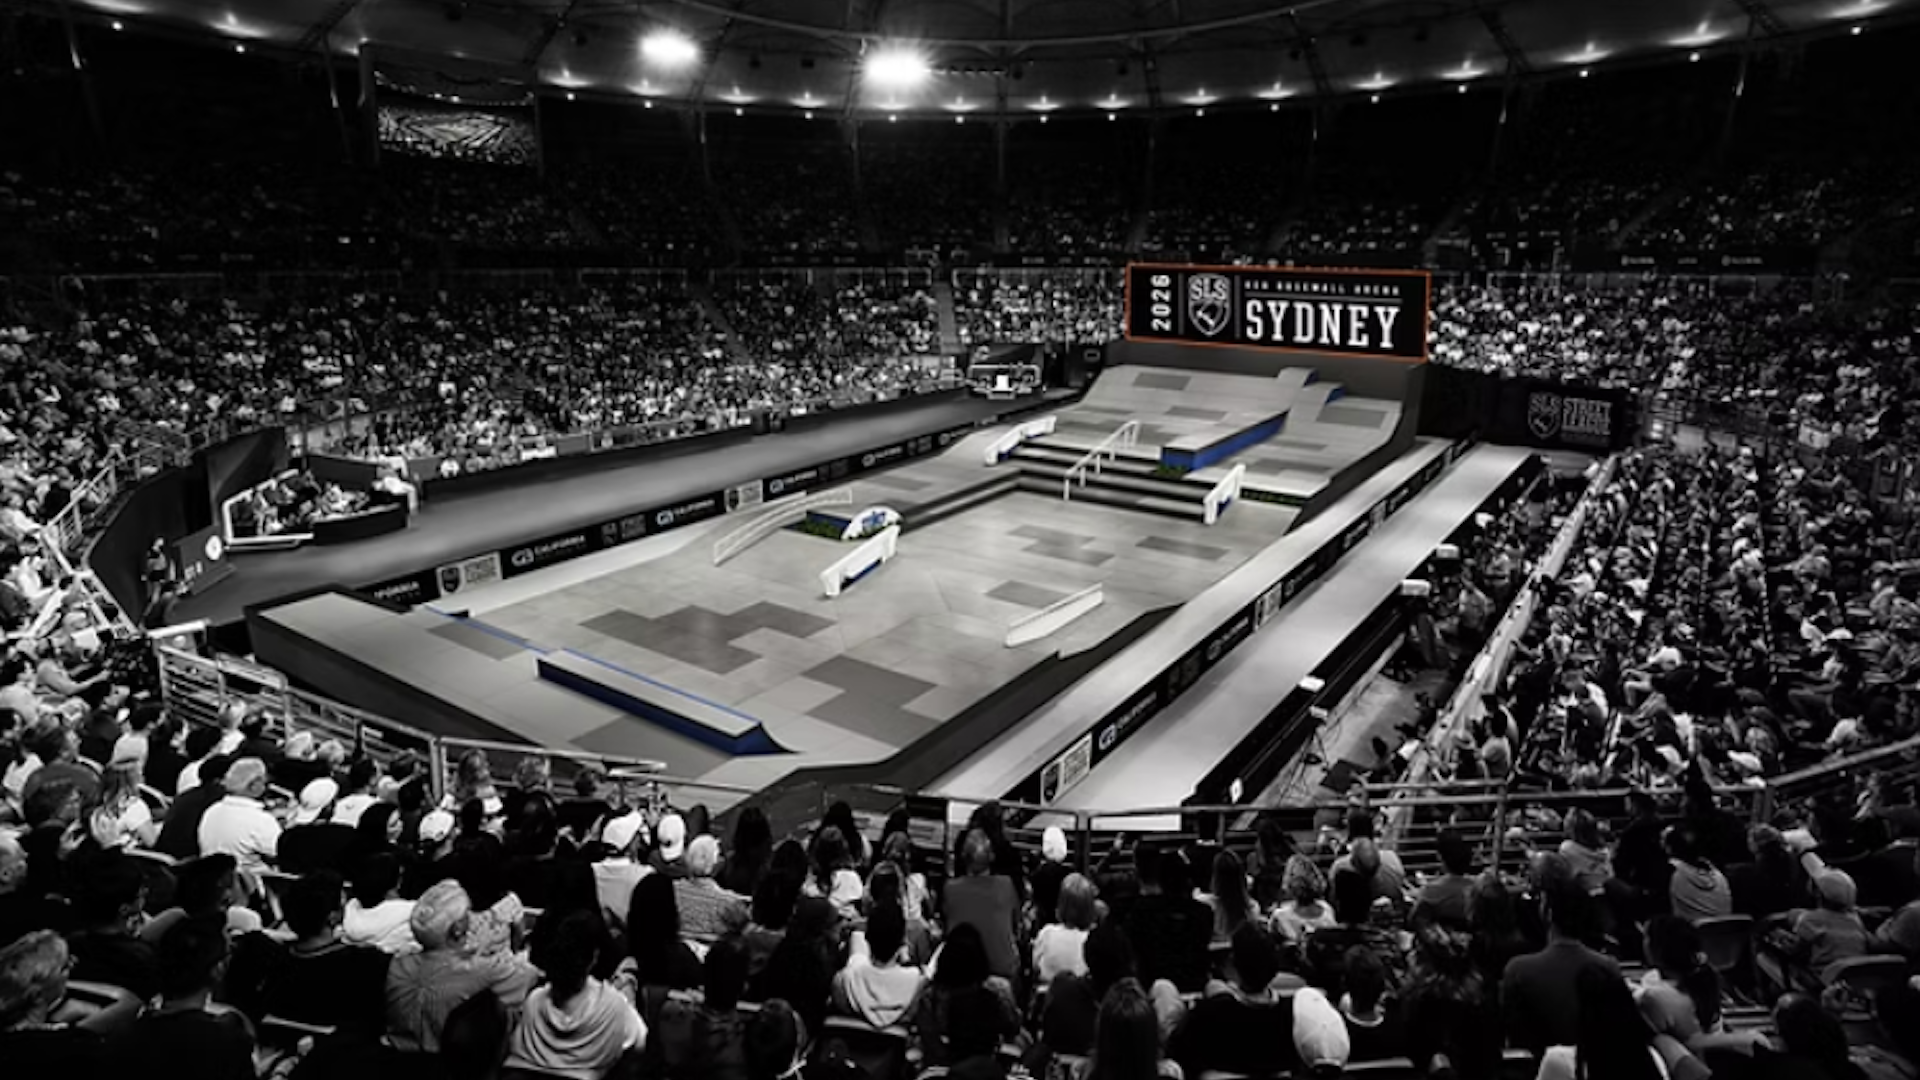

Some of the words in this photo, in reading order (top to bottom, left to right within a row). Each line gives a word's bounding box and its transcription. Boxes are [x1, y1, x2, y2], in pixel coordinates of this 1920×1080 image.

[1151, 274, 1172, 331] 2026
[1189, 276, 1229, 300] SLS
[1246, 299, 1400, 349] SYDNEY
